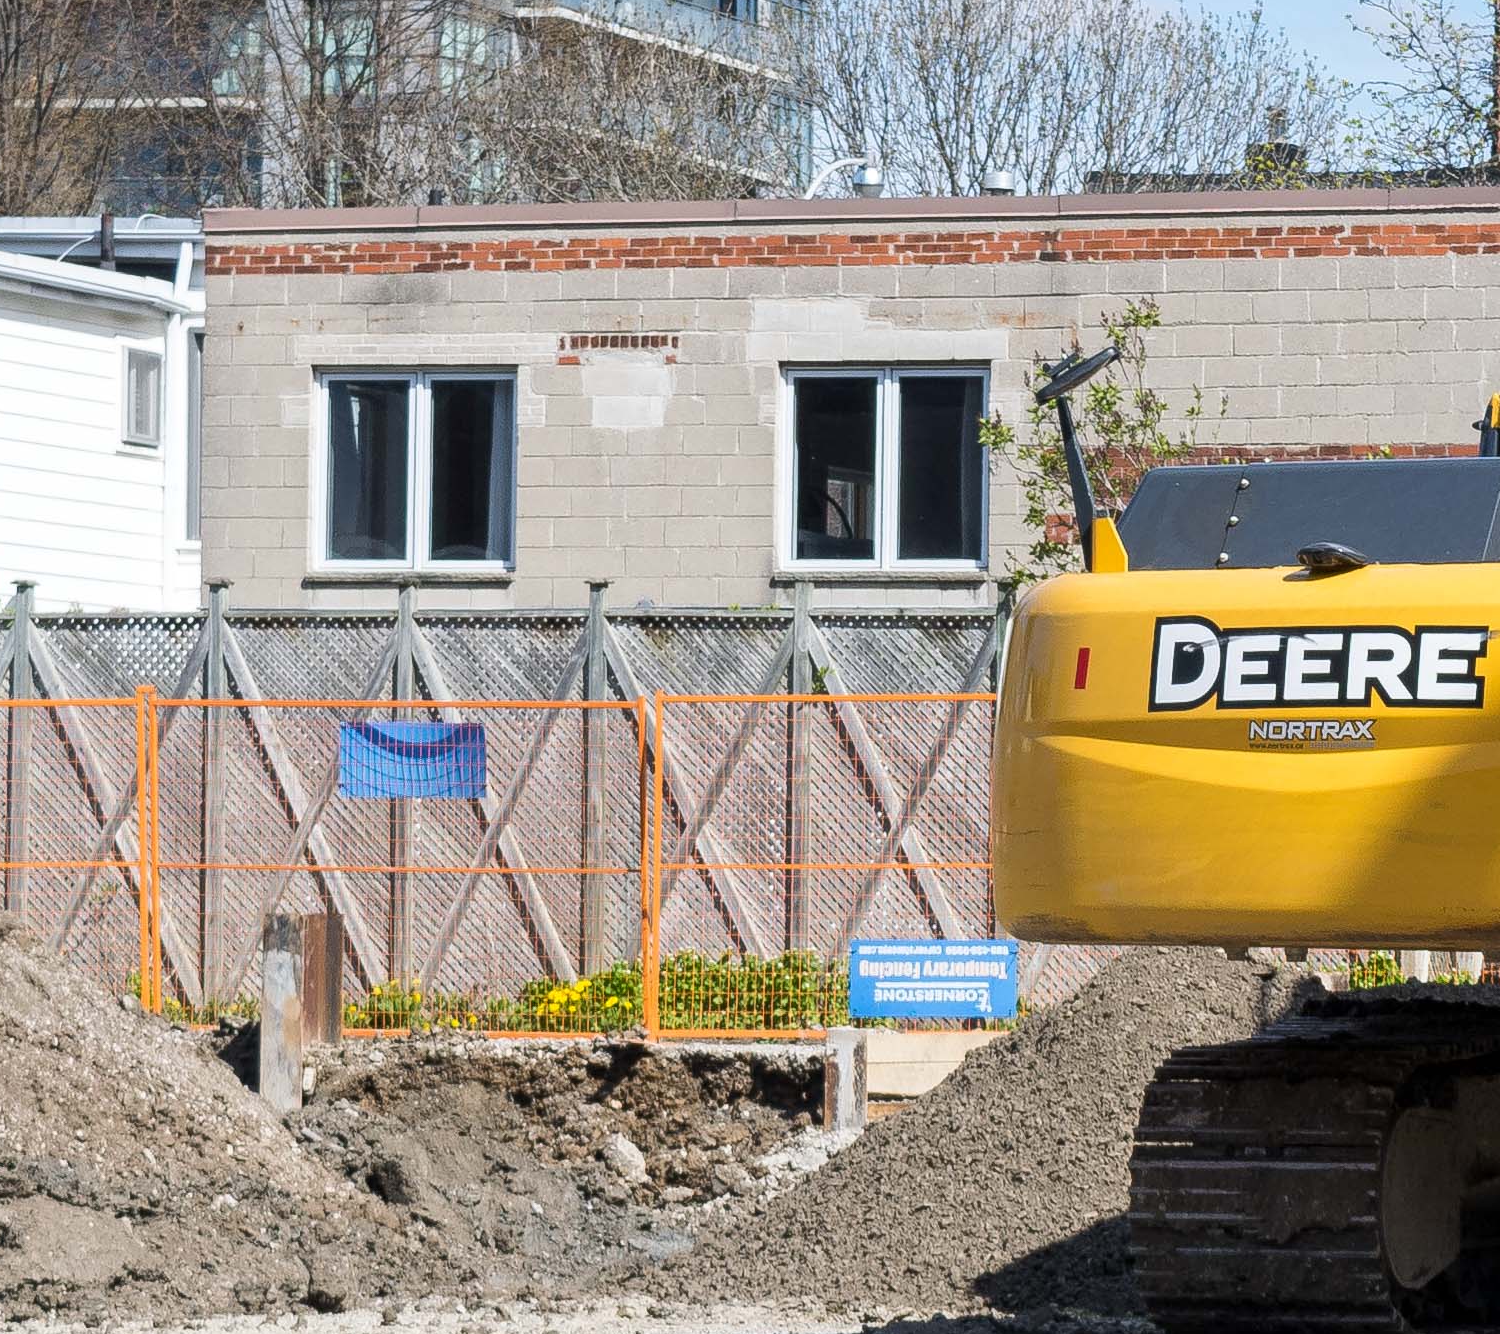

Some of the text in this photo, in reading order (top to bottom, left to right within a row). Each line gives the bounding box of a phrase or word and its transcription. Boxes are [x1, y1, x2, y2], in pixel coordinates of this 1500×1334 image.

[1153, 622, 1487, 706] DEERE
[1249, 719, 1376, 741] NORTRAX
[859, 959, 1008, 980] Temporary Fencing
[874, 988, 990, 1008] CORNERSTONE
